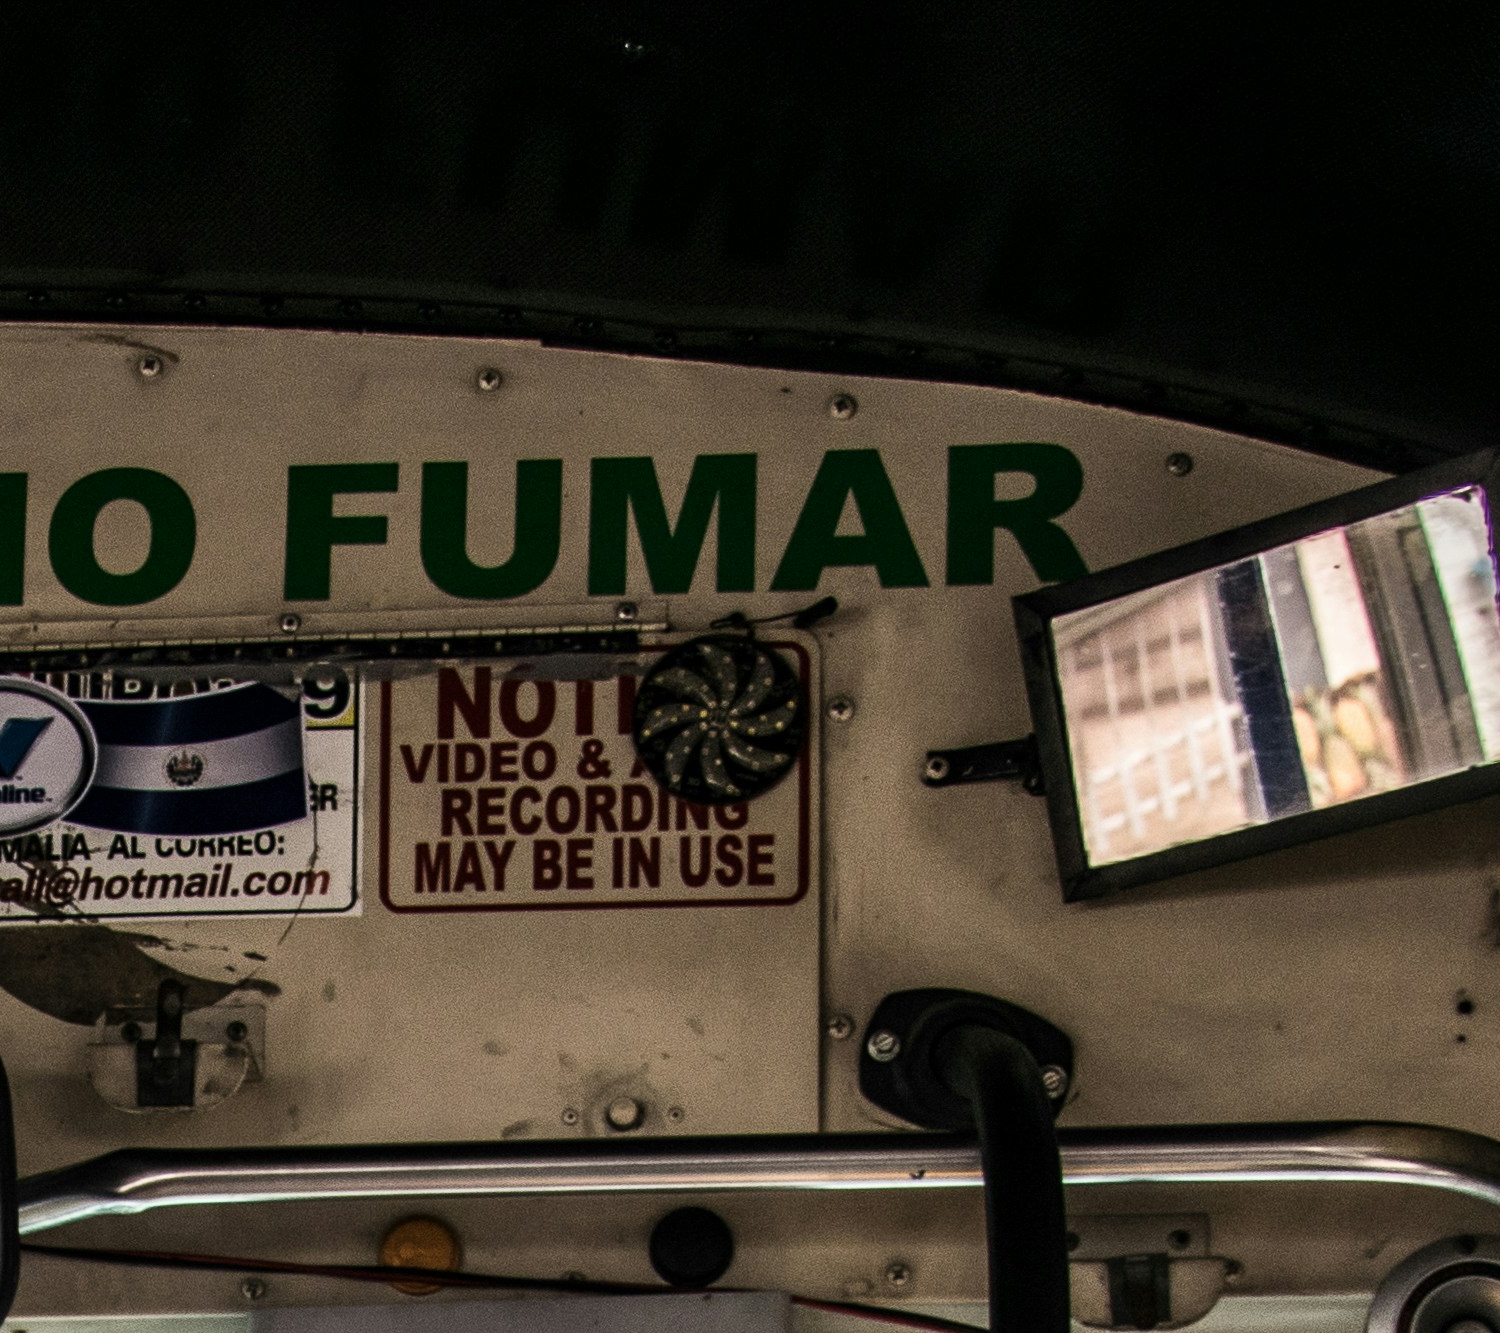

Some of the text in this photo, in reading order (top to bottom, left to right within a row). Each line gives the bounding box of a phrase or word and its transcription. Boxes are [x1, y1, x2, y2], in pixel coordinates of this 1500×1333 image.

[283, 442, 1092, 601] FUMAR
[437, 664, 637, 739] NOTI
[401, 741, 557, 783] VIDEO
[577, 738, 612, 780] &
[442, 784, 749, 837] RECORDING
[107, 835, 146, 860] AL
[156, 831, 286, 858] CORREO:
[414, 834, 776, 893] MAY BE IN USE
